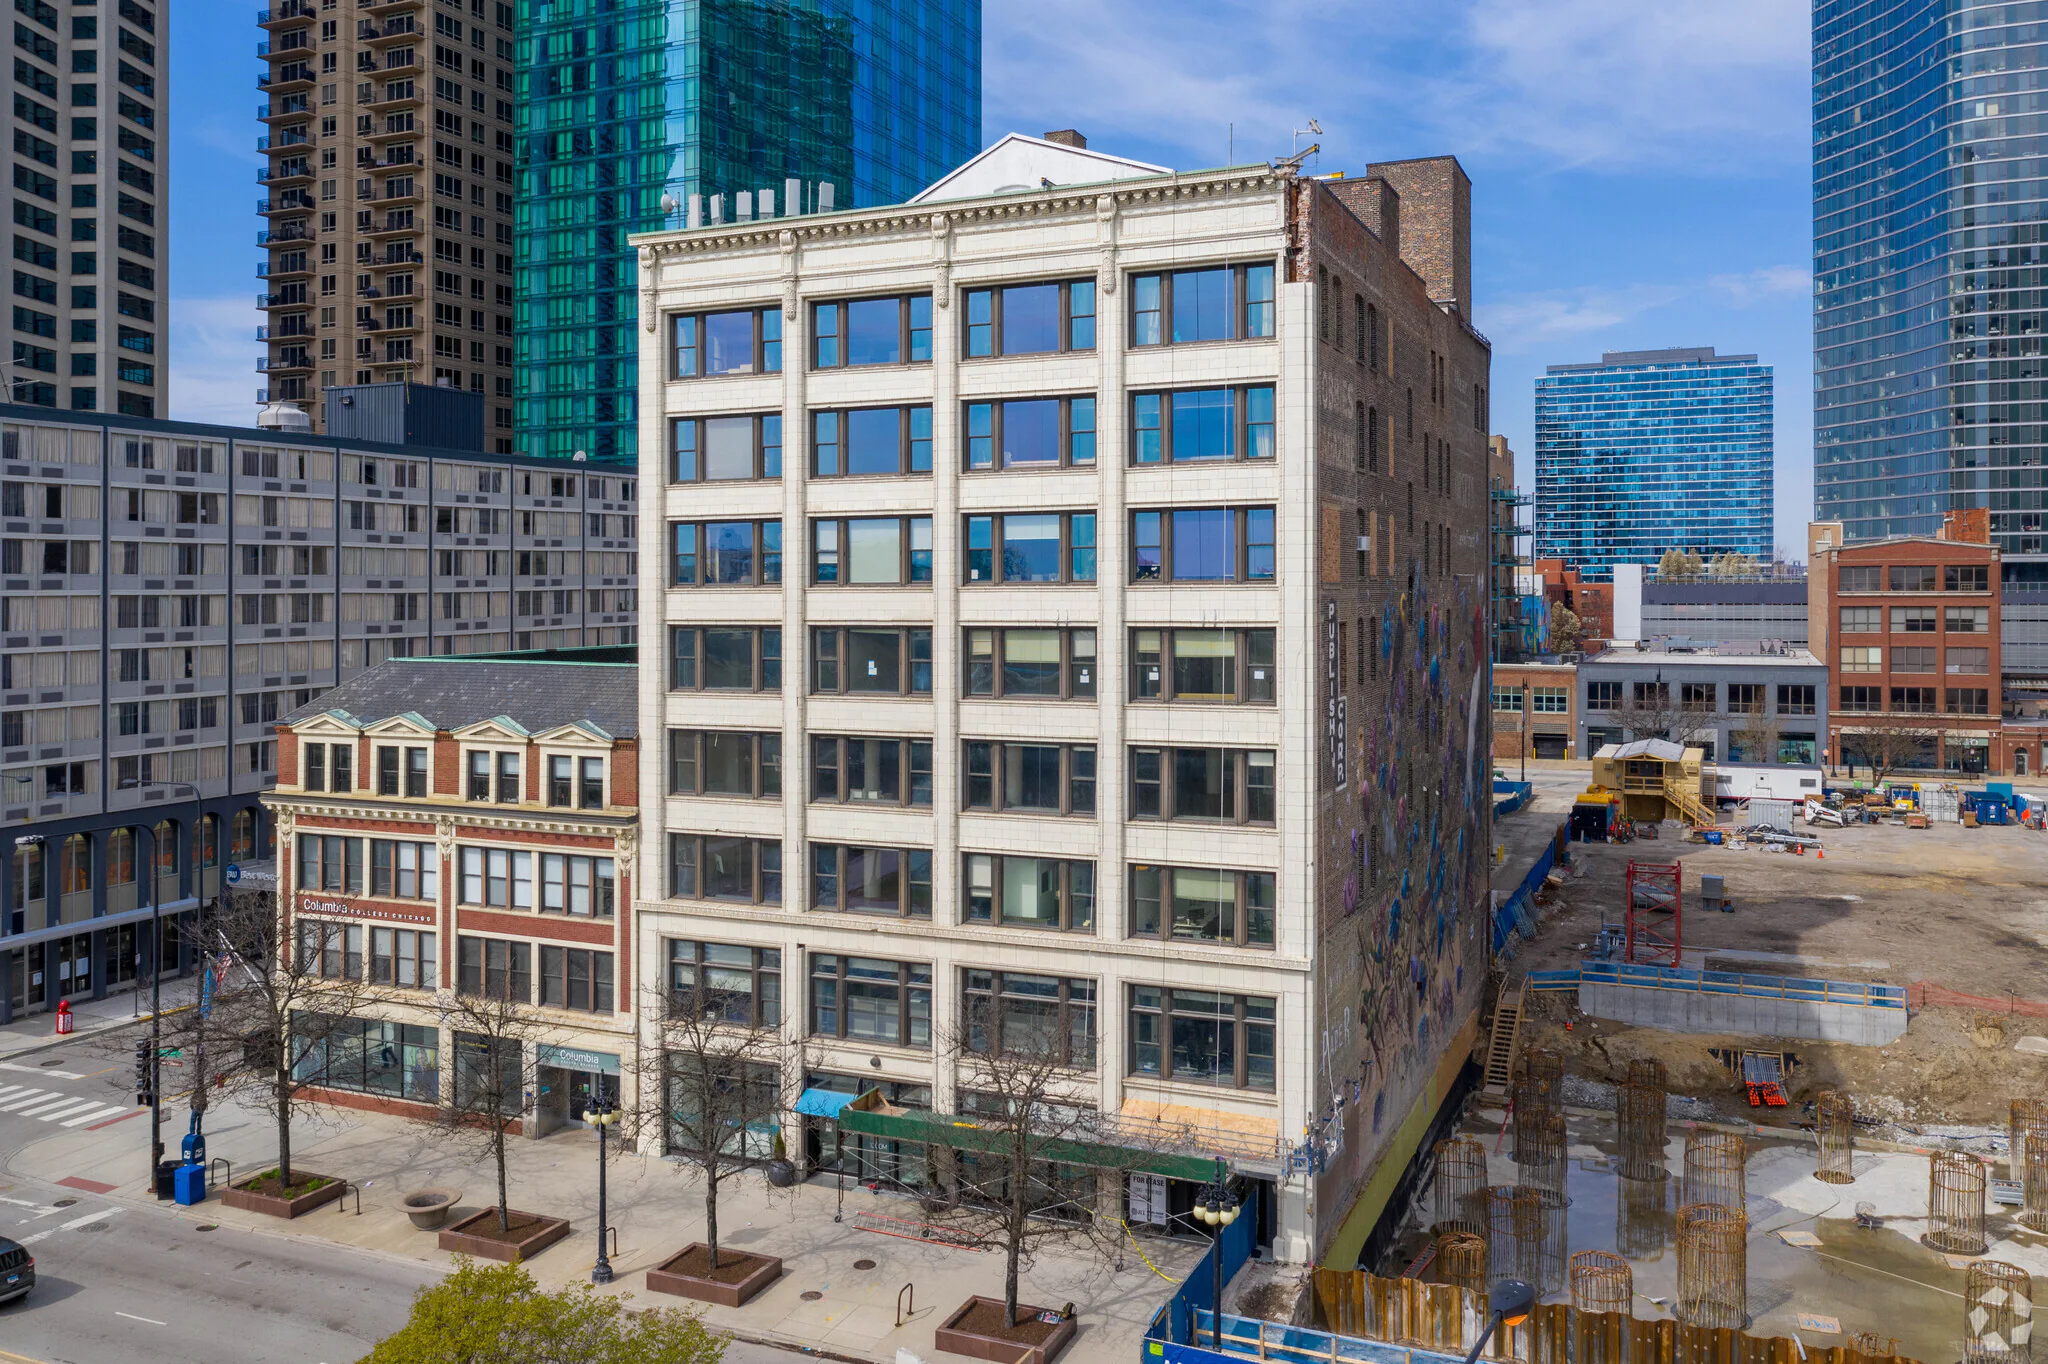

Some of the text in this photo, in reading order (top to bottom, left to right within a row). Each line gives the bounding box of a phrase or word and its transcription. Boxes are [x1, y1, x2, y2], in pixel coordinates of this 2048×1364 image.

[303, 898, 348, 914] Columbia
[350, 908, 431, 922] COLLEGE CHICAGO
[560, 1050, 599, 1063] Columbia
[1146, 1178, 1164, 1186] LASE
